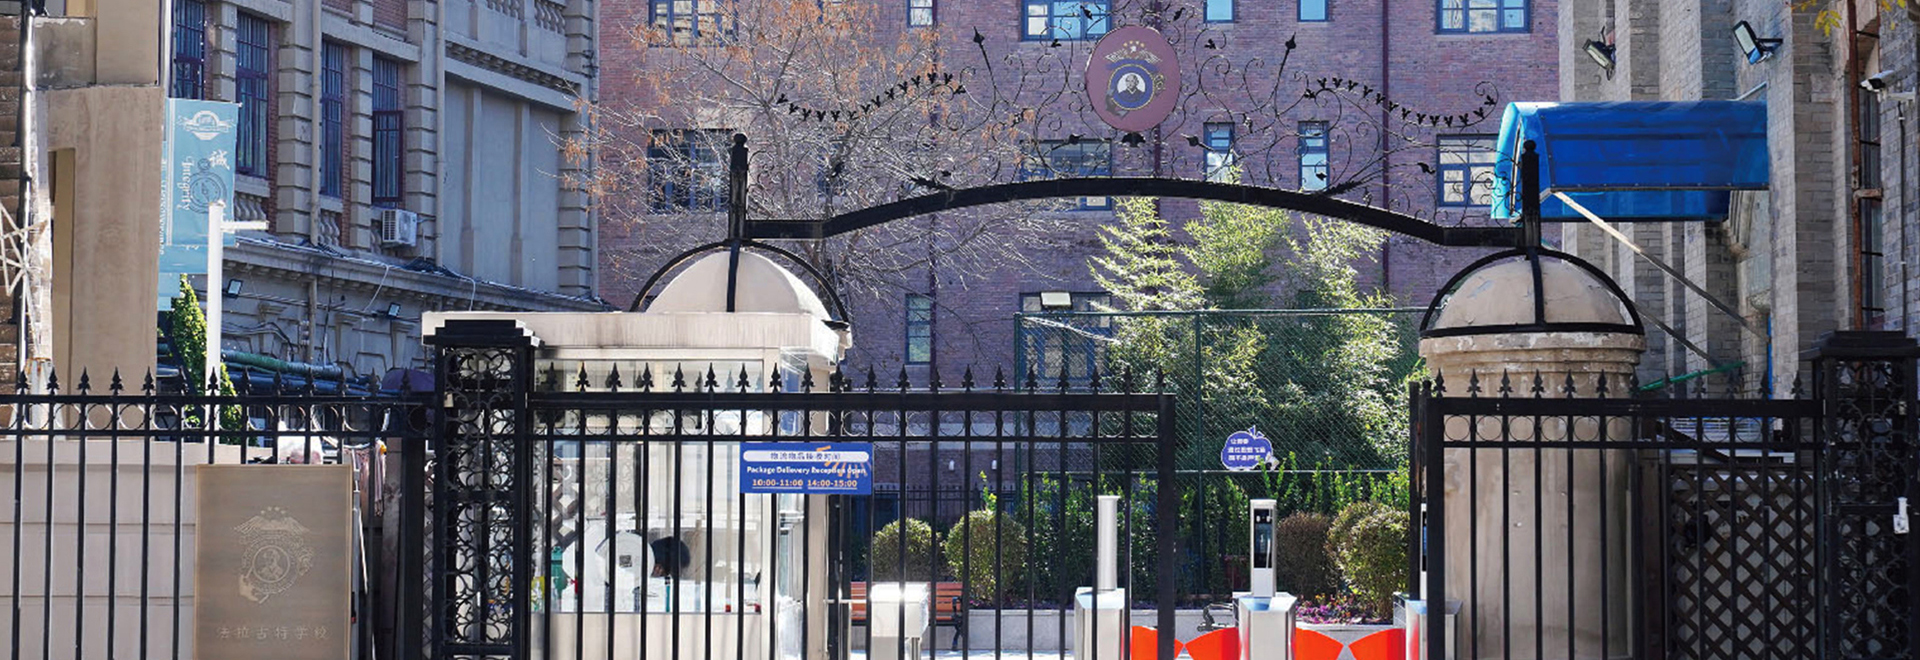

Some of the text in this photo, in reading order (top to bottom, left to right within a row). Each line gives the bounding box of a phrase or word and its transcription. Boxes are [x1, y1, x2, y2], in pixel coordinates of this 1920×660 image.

[177, 155, 194, 211] Integrity
[746, 466, 775, 475] Package
[811, 466, 845, 475] Reception
[847, 466, 867, 475] Open
[752, 479, 857, 487] 10:00-11:00 14:00-15:00
[217, 626, 329, 640] 法拉古特学校
